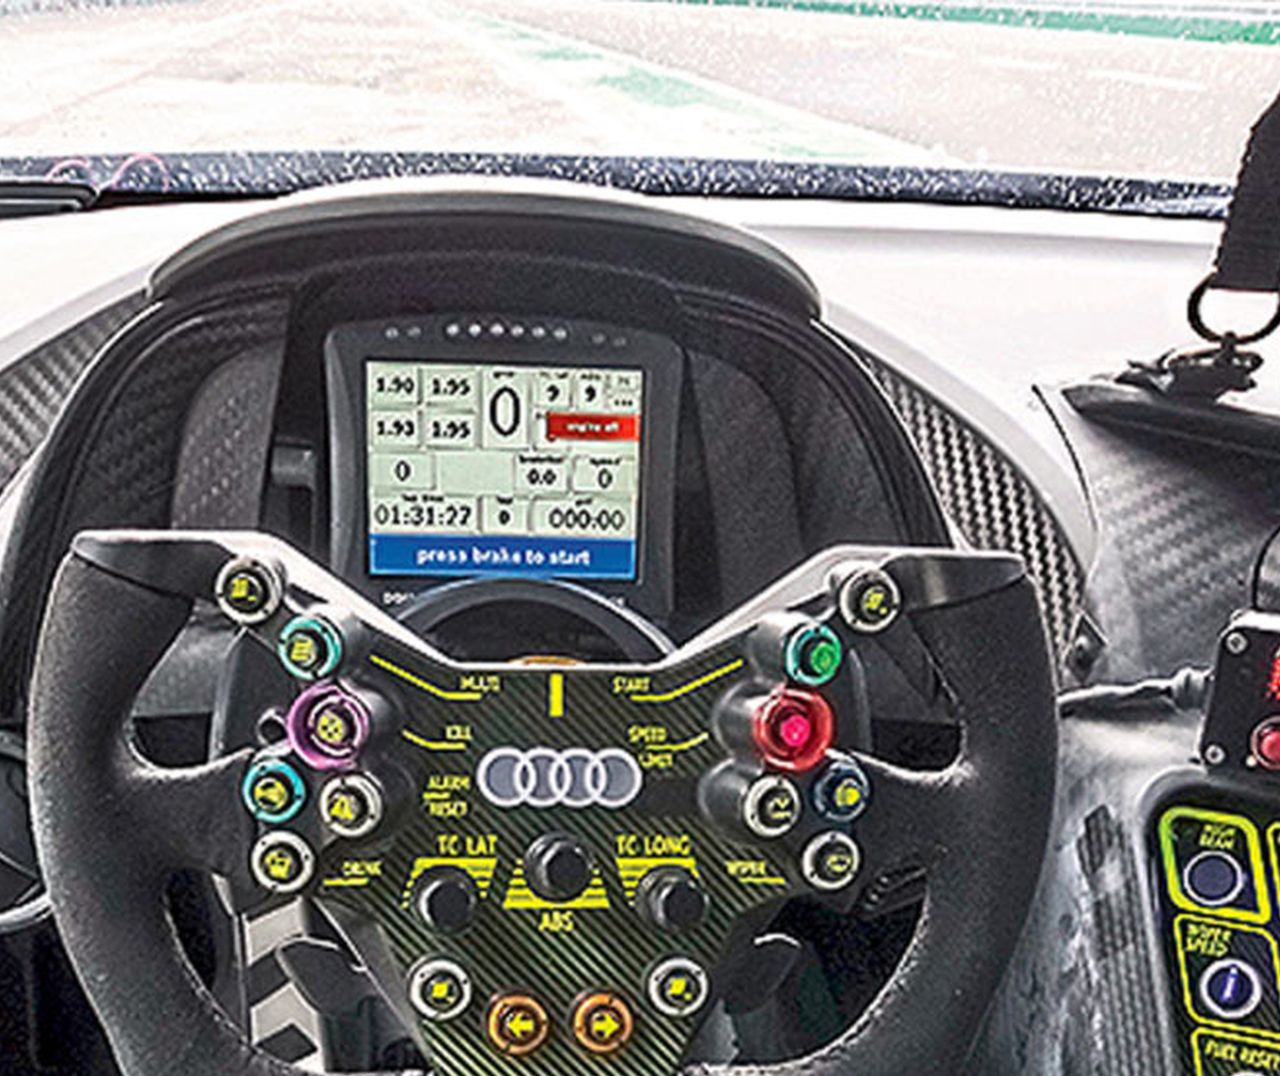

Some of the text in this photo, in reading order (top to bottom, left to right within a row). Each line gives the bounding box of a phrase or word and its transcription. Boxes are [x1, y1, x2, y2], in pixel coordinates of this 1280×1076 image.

[489, 385, 521, 437] 0
[394, 459, 411, 482] 0
[526, 468, 557, 486] 0.0
[597, 467, 613, 489] 0
[415, 546, 592, 567] press brake to start
[436, 834, 499, 856] TC LAT
[616, 834, 692, 857] TC LONG
[537, 911, 575, 932] ABS
